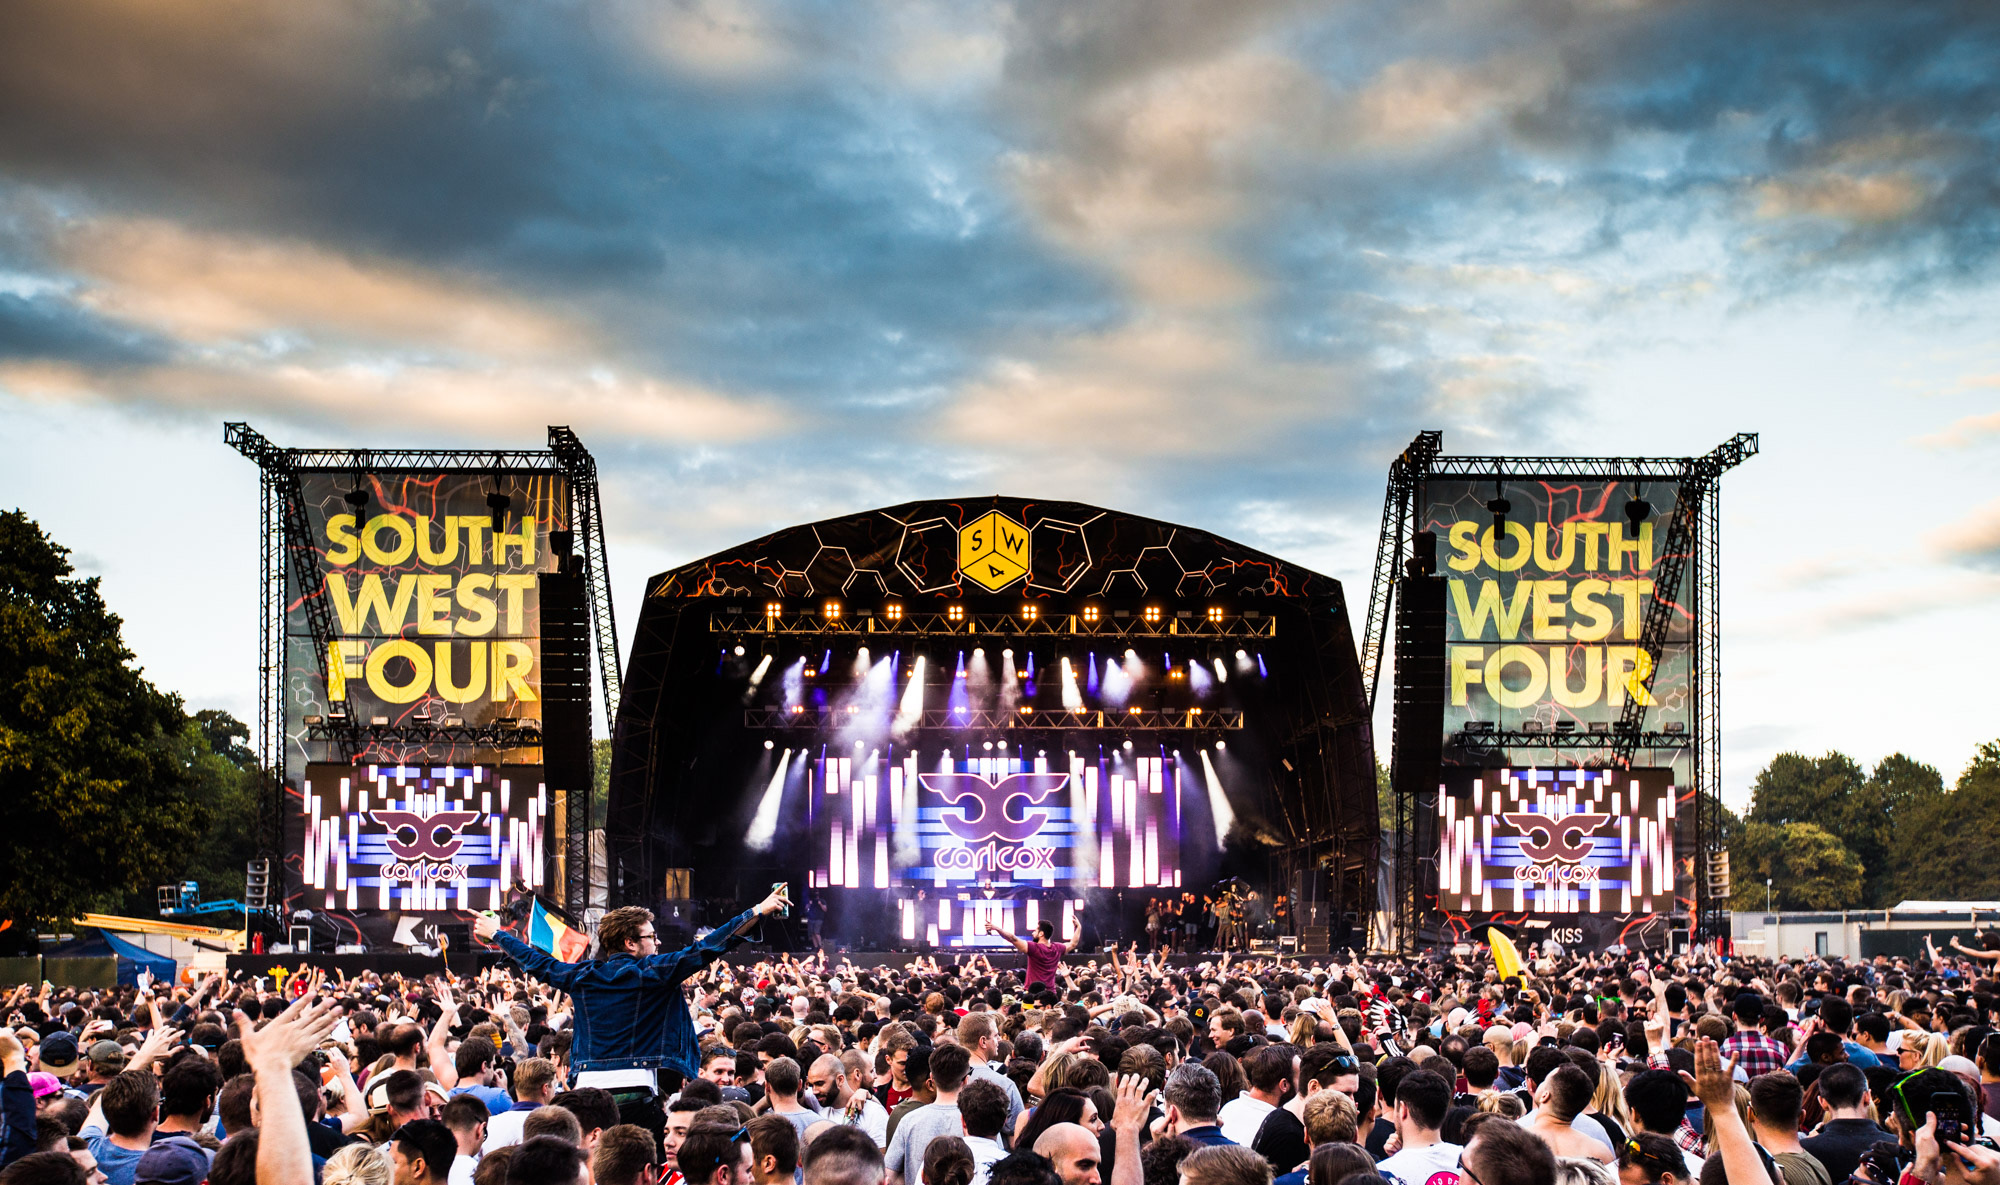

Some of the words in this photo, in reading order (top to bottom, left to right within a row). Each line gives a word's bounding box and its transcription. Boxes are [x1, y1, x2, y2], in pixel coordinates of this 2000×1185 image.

[325, 513, 535, 566] SOUTH
[1448, 520, 1653, 572] SOUTH
[326, 573, 536, 637] WEST
[1449, 578, 1653, 641] WEST
[327, 640, 538, 704] FOUR
[1451, 645, 1658, 709] FOUR
[1551, 927, 1583, 943] KISS
